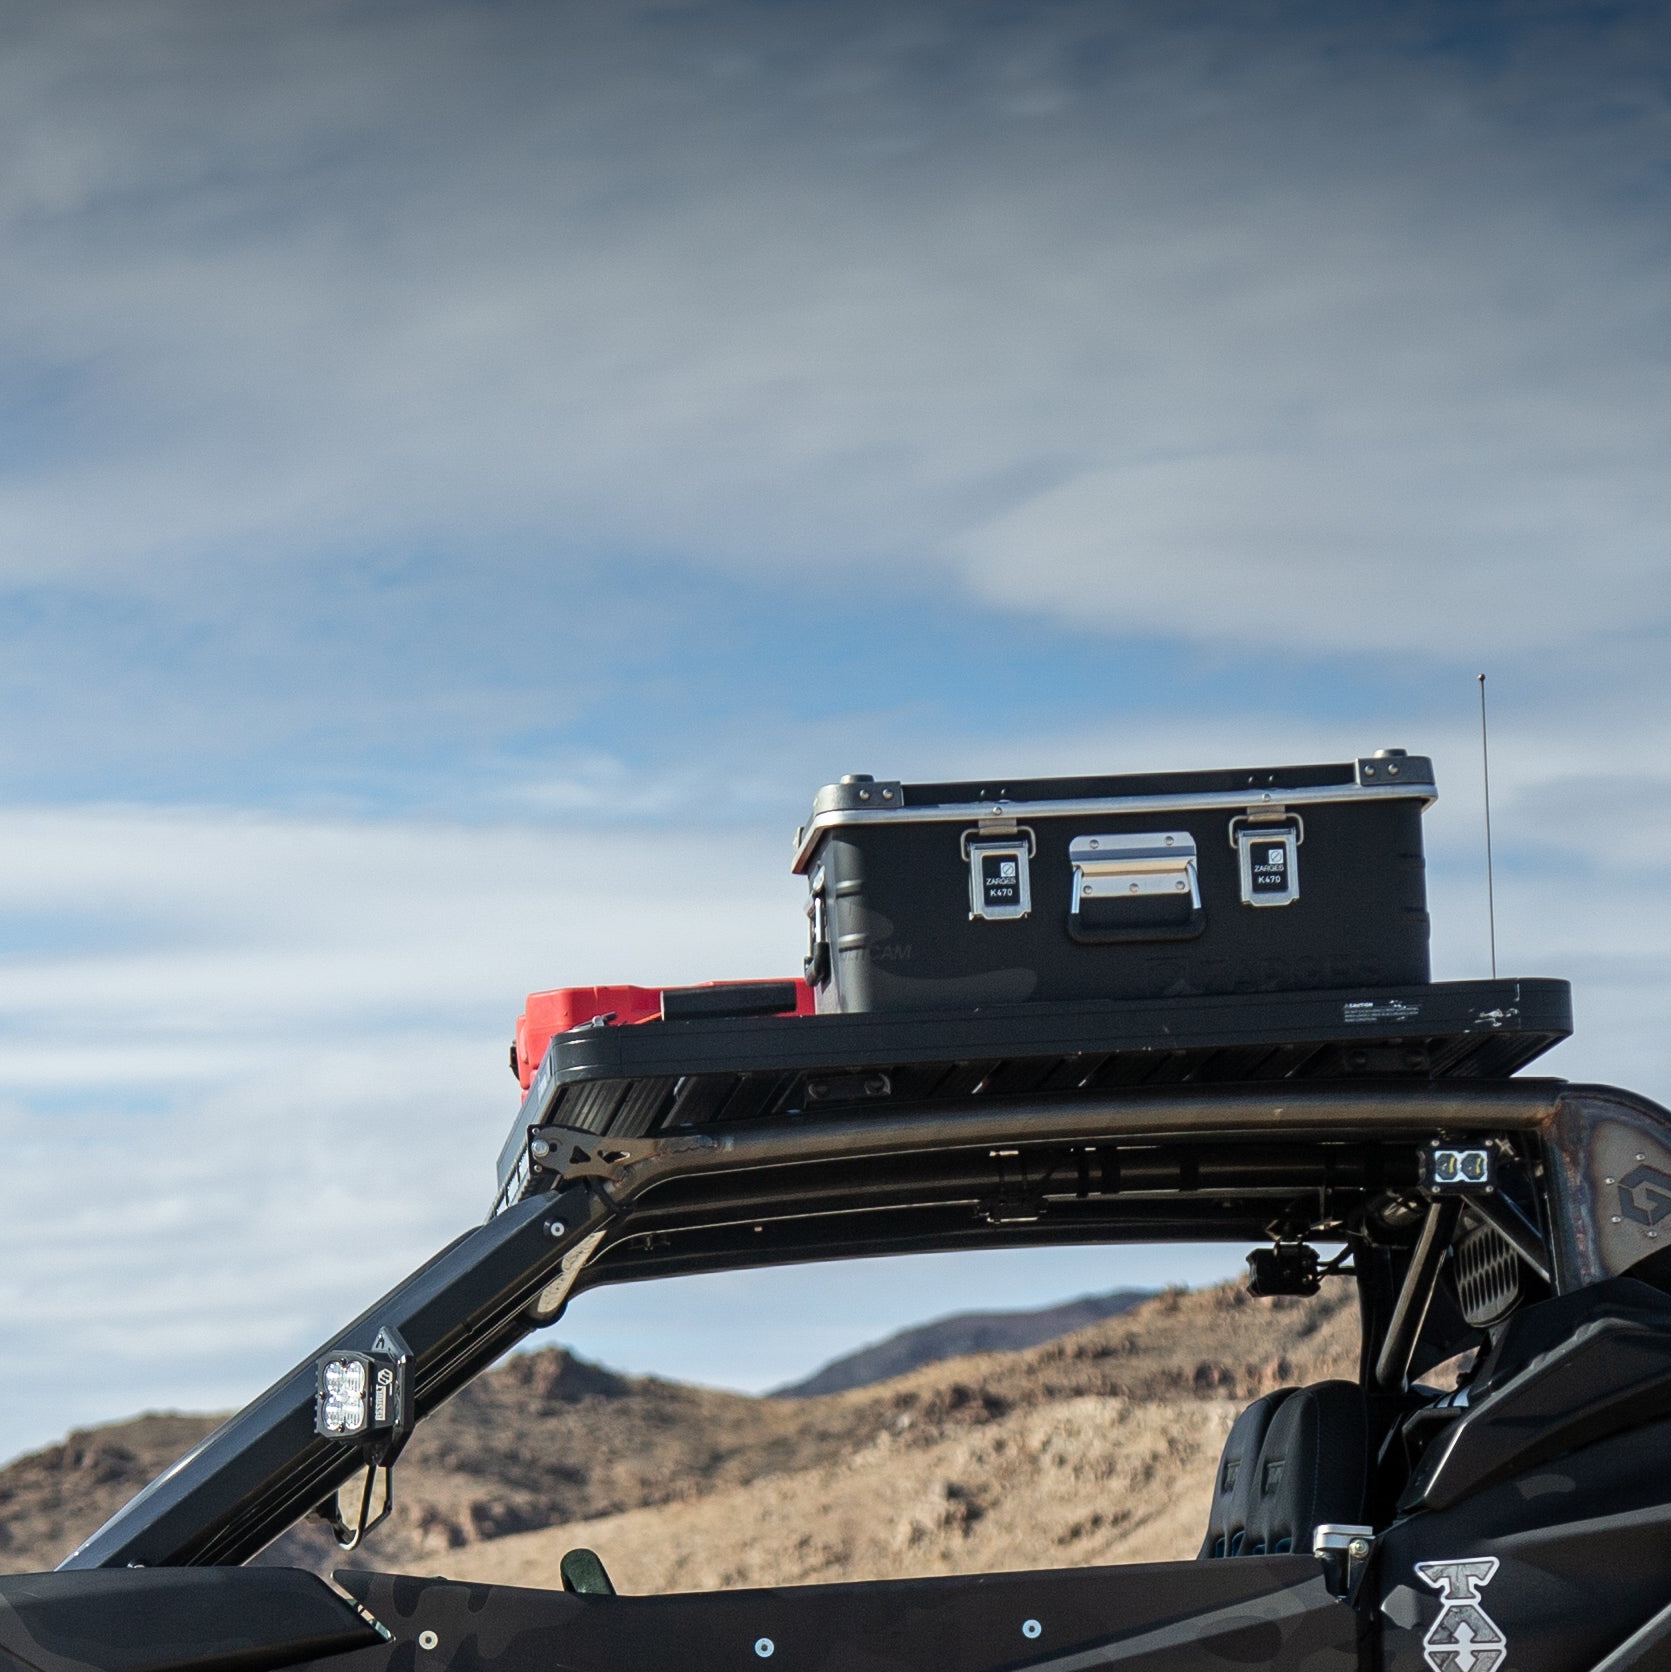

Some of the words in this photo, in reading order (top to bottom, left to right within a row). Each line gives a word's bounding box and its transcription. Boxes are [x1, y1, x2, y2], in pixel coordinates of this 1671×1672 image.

[1254, 864, 1284, 873] ZARGES
[986, 877, 1016, 886] ZARGES
[1258, 875, 1281, 884] K470
[990, 888, 1013, 897] K470
